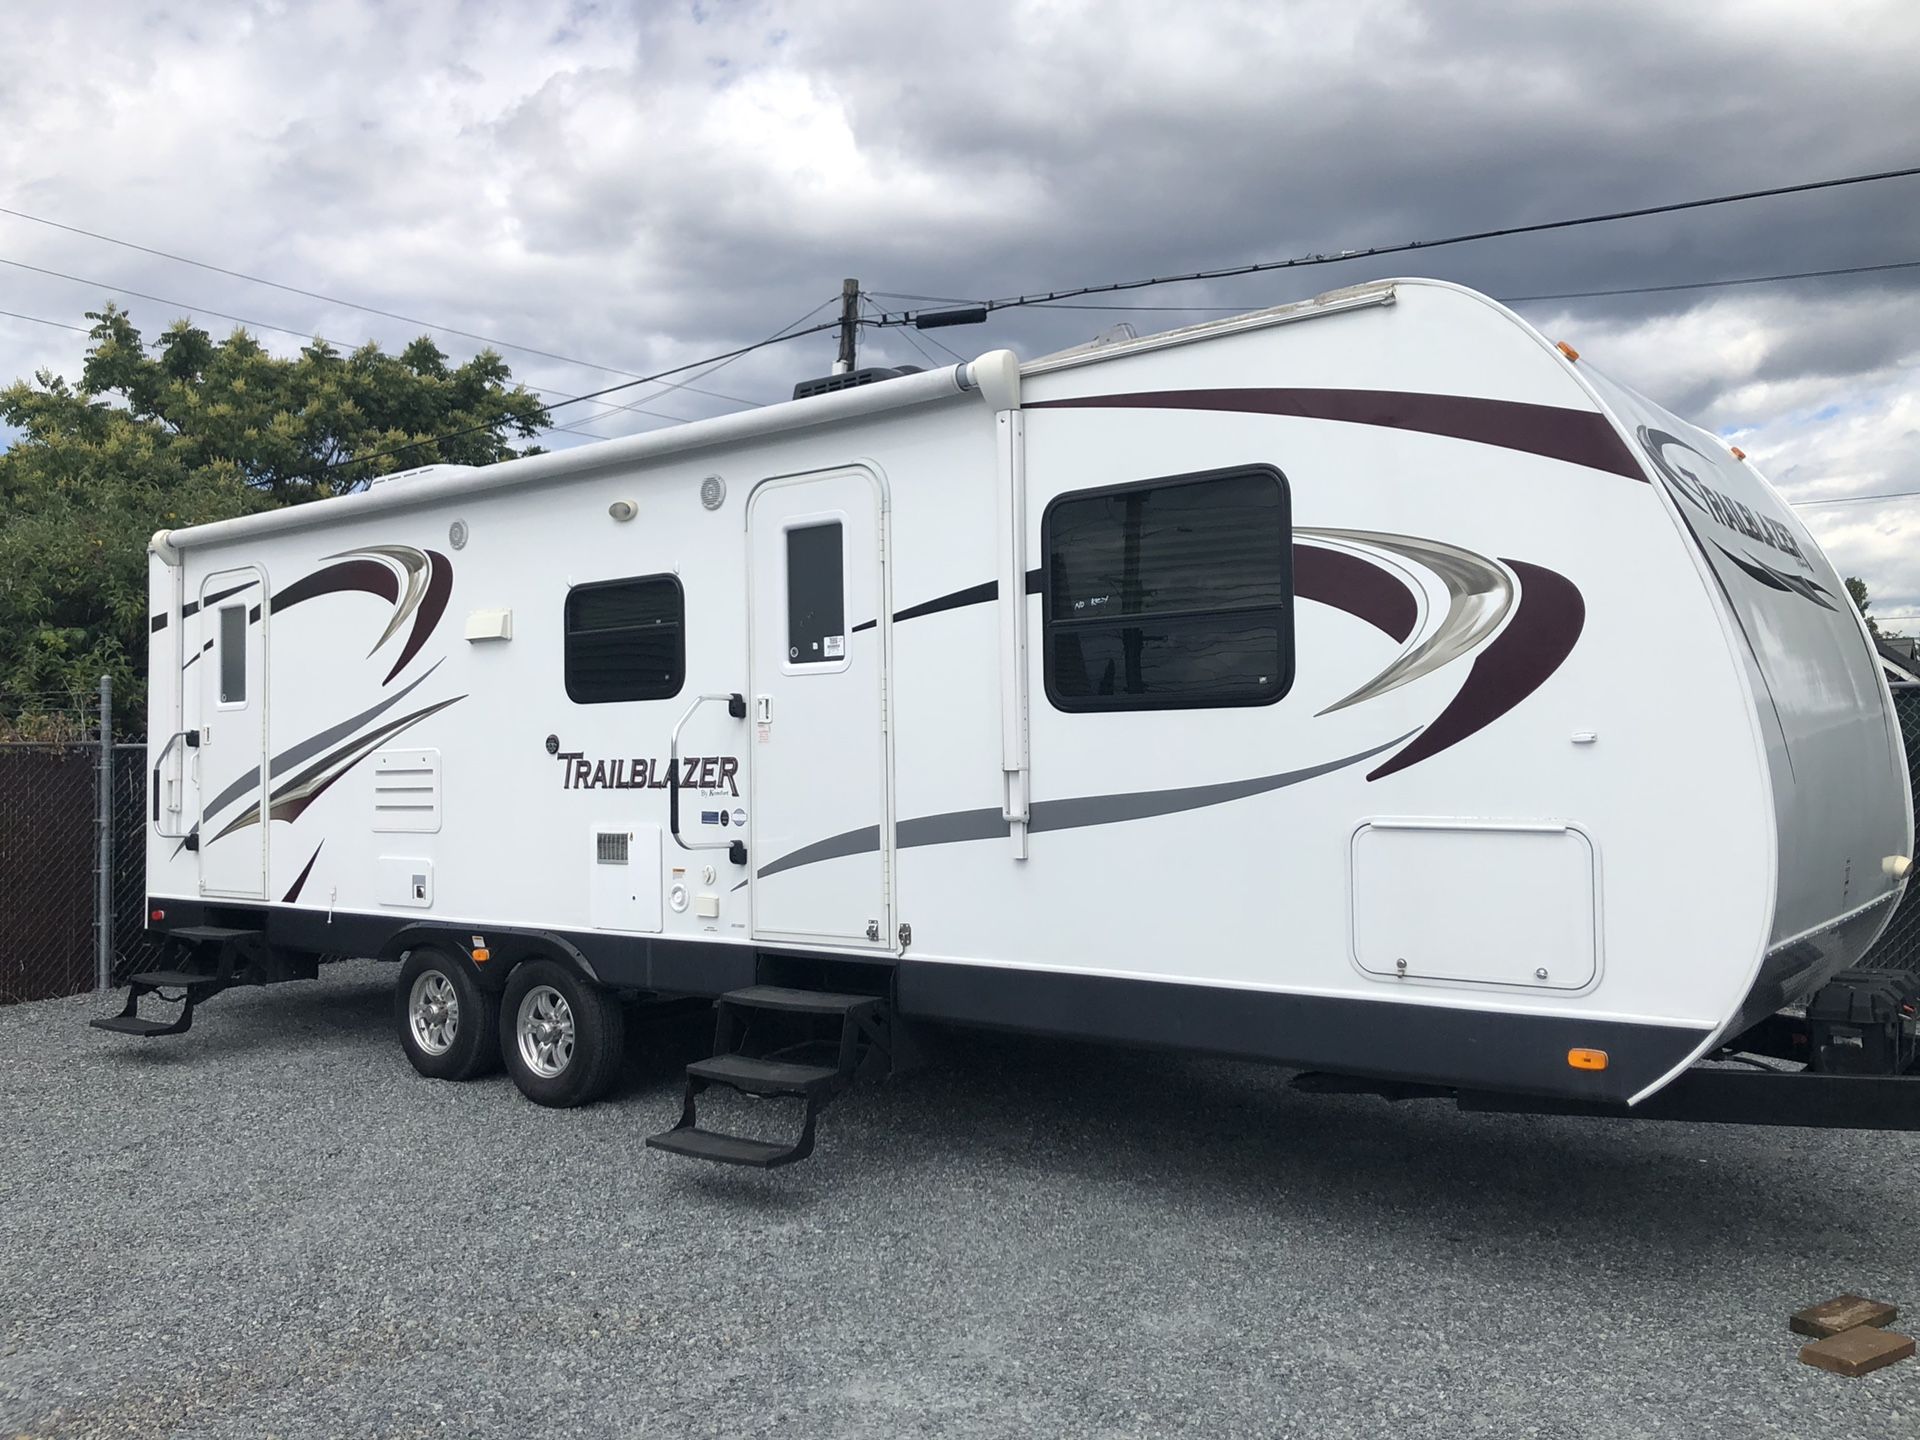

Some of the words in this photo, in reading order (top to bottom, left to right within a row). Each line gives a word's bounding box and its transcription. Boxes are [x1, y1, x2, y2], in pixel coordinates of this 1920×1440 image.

[1675, 463, 1815, 573] TRAILBLAZER
[1074, 600, 1085, 611] NO
[1090, 595, 1109, 606] KEY
[556, 752, 740, 797] TRAILBLAZER
